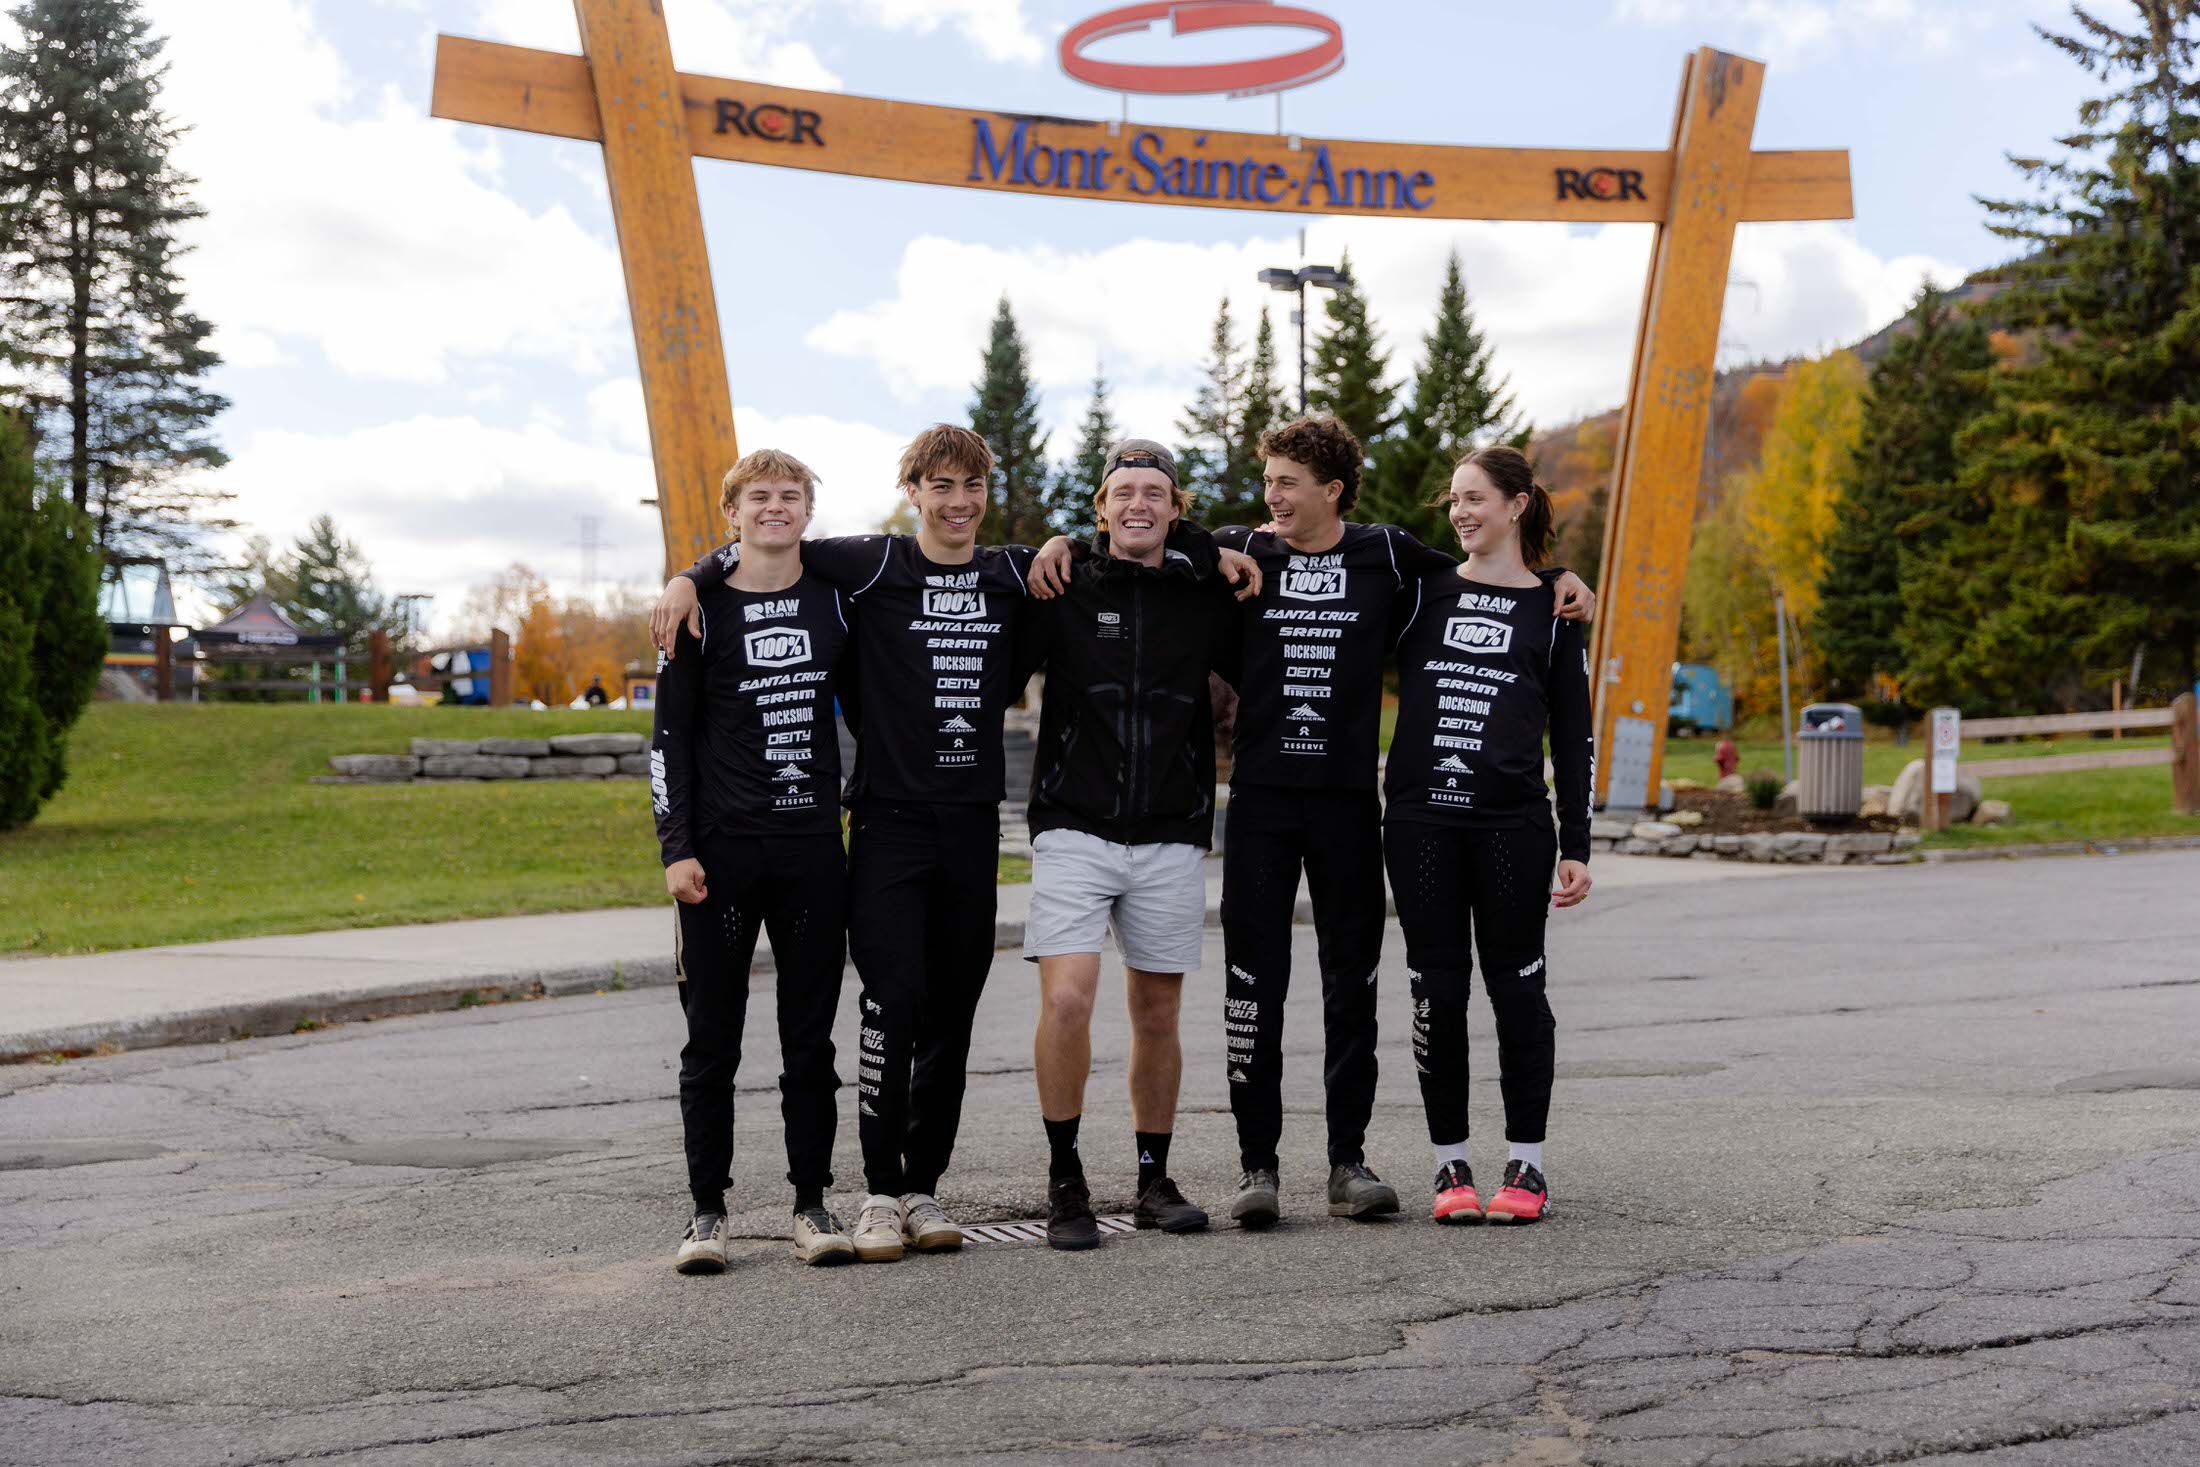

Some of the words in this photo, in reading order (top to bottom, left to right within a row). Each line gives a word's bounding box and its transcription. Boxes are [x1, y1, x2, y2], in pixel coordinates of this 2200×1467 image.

[714, 97, 825, 146] RCR
[1554, 166, 1648, 201] RCR
[1308, 553, 1345, 568] RAW
[944, 571, 980, 588] RAW
[1289, 571, 1338, 593] 100%
[764, 599, 800, 614] RAW
[932, 592, 978, 612] 100%
[1478, 594, 1518, 612] RAW
[1262, 609, 1317, 621] SANTA
[1318, 611, 1360, 622] CRUZ
[908, 620, 963, 632] SANTA
[963, 622, 1002, 633] CRUZ
[1278, 627, 1343, 639] SRAM
[1453, 624, 1503, 646] 100%
[755, 635, 803, 659] 100%
[926, 638, 988, 650] SRAM
[1283, 644, 1336, 660] ROCKSHOX
[932, 655, 983, 672] ROCKSHOX
[1286, 666, 1332, 679] DEITY
[1423, 660, 1474, 675] SANTA
[1475, 667, 1519, 684] CRUZ
[738, 673, 792, 692] SANTA
[792, 671, 828, 683] CRUZ
[936, 677, 980, 690] DEITY
[1436, 678, 1499, 696] SRAM
[755, 689, 816, 706] SRAM
[1283, 684, 1332, 698] PIRELLI
[934, 695, 982, 709] PIRELLI
[1438, 695, 1491, 716] ROCKSHOX
[763, 706, 814, 727] ROCKSHOX
[1438, 716, 1484, 733] DEITY
[767, 729, 812, 746] DEITY
[1433, 734, 1483, 751] PIRELLI
[765, 748, 813, 761] PIRELLI
[1284, 742, 1324, 751] RESERVE
[939, 754, 975, 763] RESERVE
[651, 749, 671, 815] 100%
[775, 796, 814, 806] RESERVE
[1431, 792, 1470, 804] RESERVE
[1230, 964, 1257, 986] 100%
[1225, 997, 1258, 1011] SANTA
[1228, 1008, 1259, 1020] CRUZ
[1225, 1021, 1258, 1032] SRAM
[1227, 1035, 1255, 1049] OCKSHOX
[860, 1050, 886, 1065] RAM
